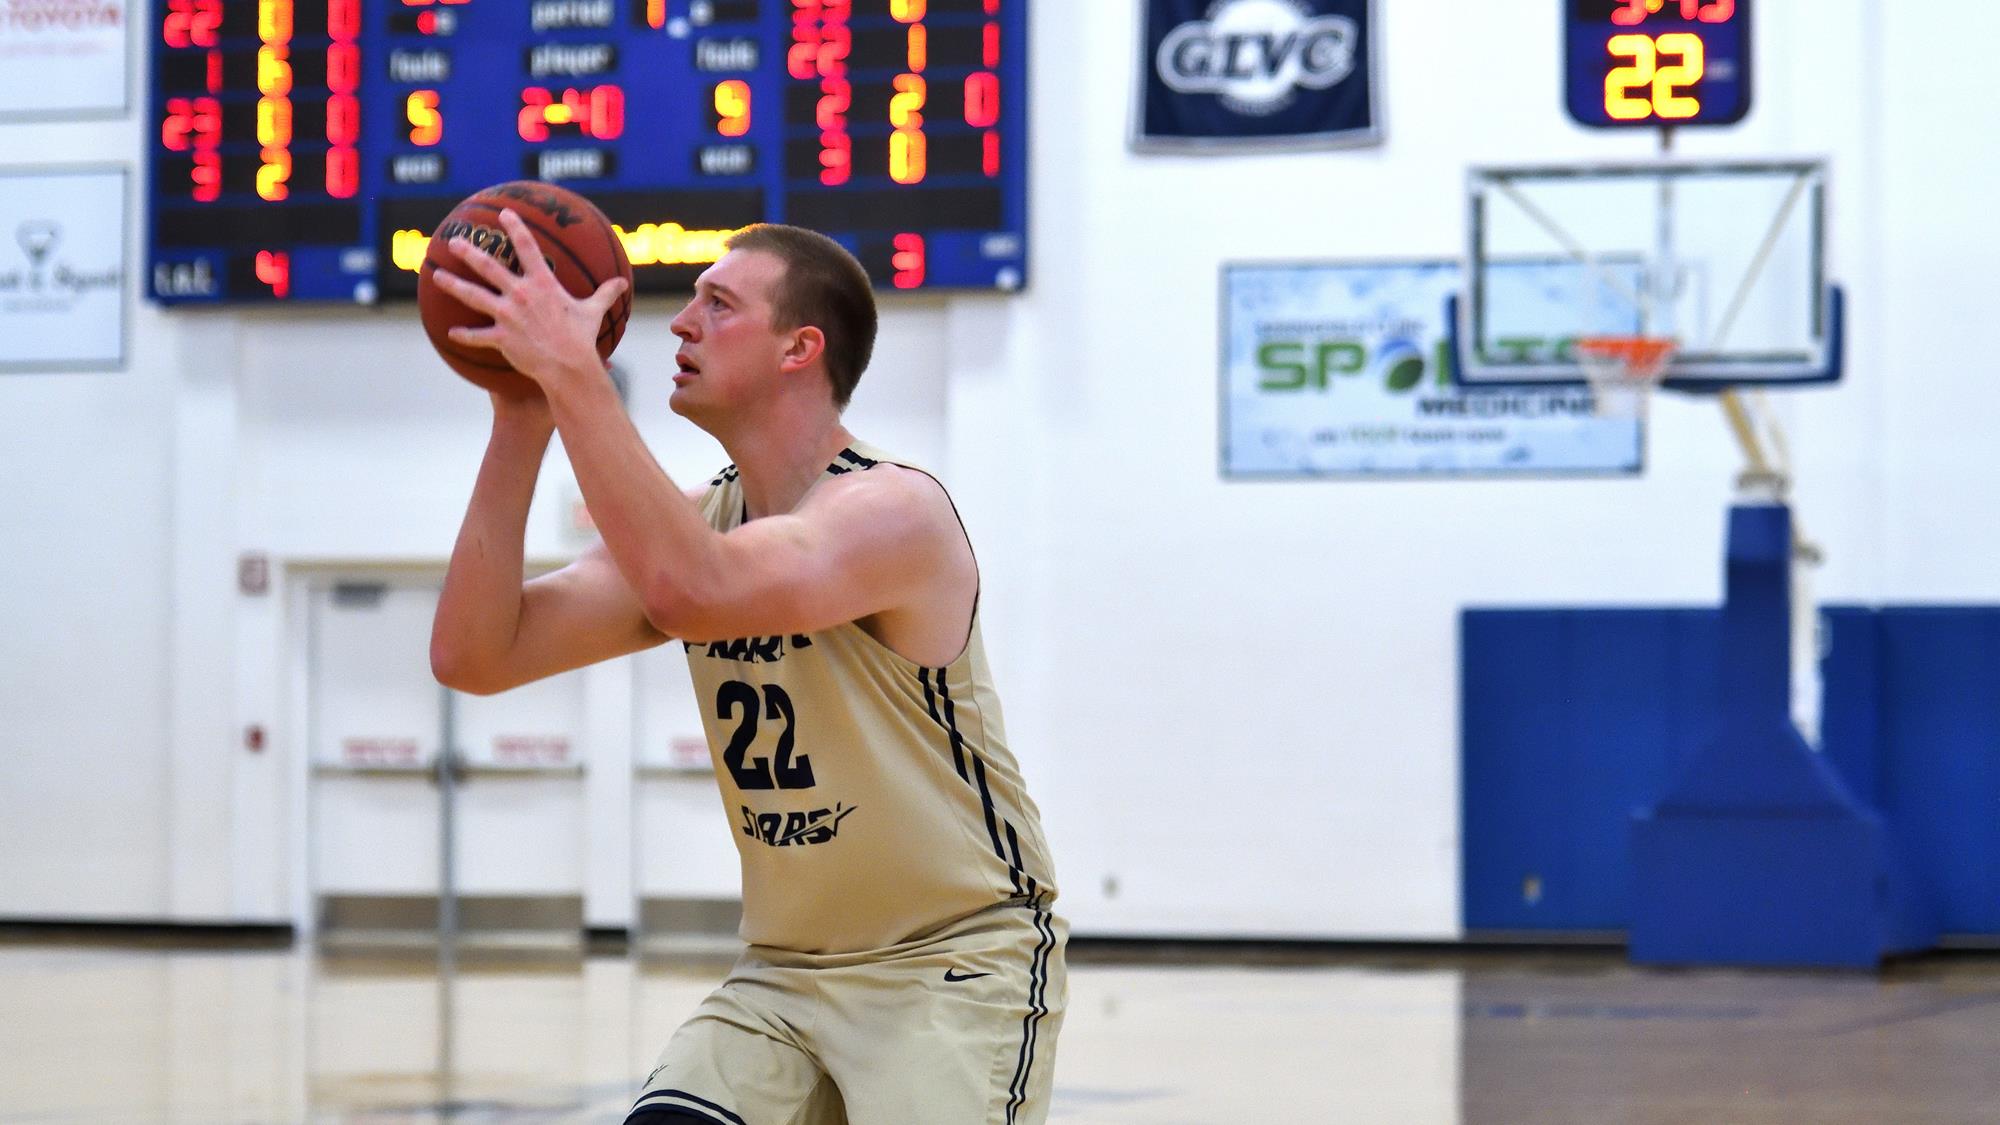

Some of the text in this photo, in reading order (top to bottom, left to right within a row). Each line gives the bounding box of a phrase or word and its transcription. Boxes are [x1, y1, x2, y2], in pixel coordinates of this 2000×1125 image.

[1164, 22, 1352, 88] GLVC
[1605, 34, 1703, 119] 22
[406, 89, 443, 146] 5
[964, 72, 999, 128] 0
[889, 129, 927, 184] 0
[891, 233, 926, 288] 3
[716, 680, 816, 790] 22
